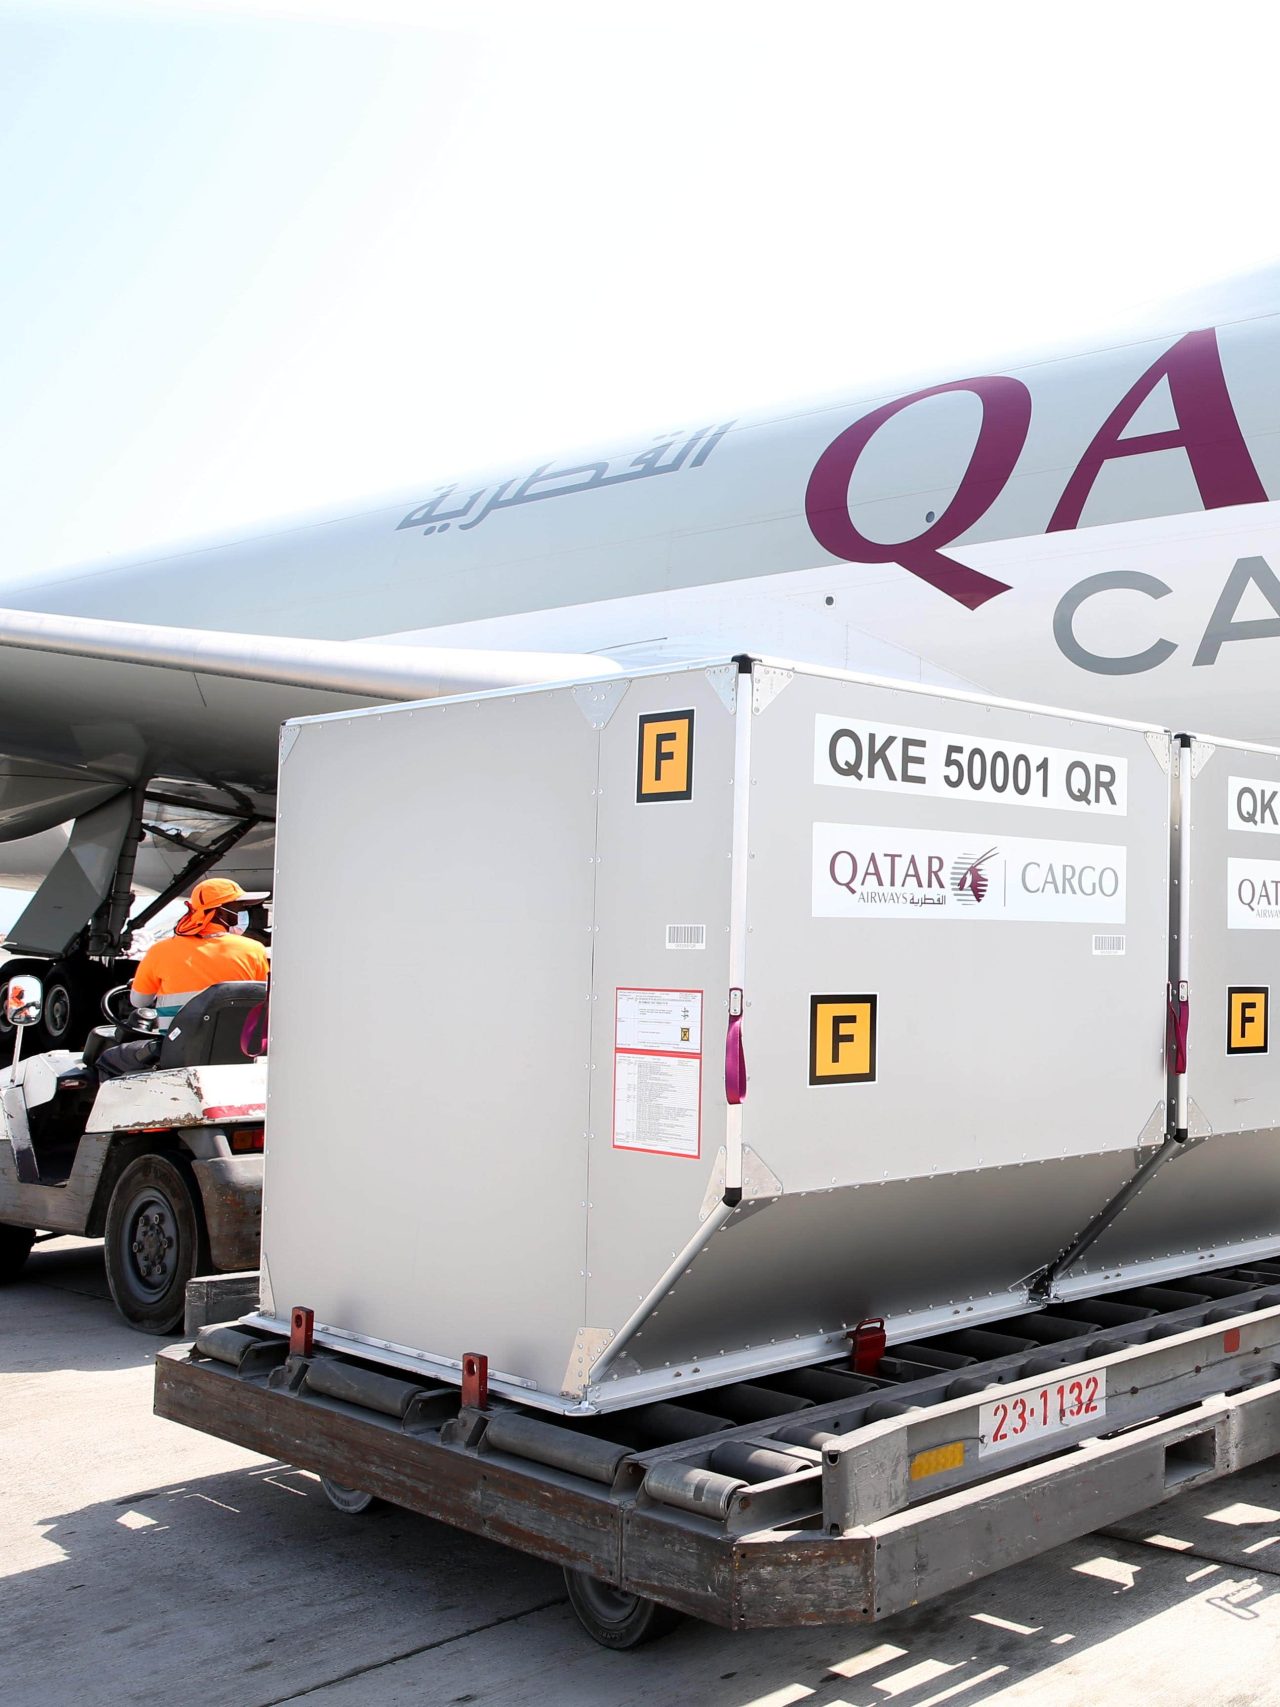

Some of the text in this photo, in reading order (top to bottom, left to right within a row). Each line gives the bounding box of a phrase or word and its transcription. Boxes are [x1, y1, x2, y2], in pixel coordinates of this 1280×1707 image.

[394, 418, 740, 536] القطرية
[655, 732, 677, 781] F
[828, 727, 1118, 806] QKE 50001 QR
[829, 850, 1119, 898] QATAR CARGO
[857, 891, 908, 905] AIRWAYS
[909, 893, 947, 907] القطرية
[832, 1014, 857, 1064] F
[1240, 1001, 1256, 1039] F
